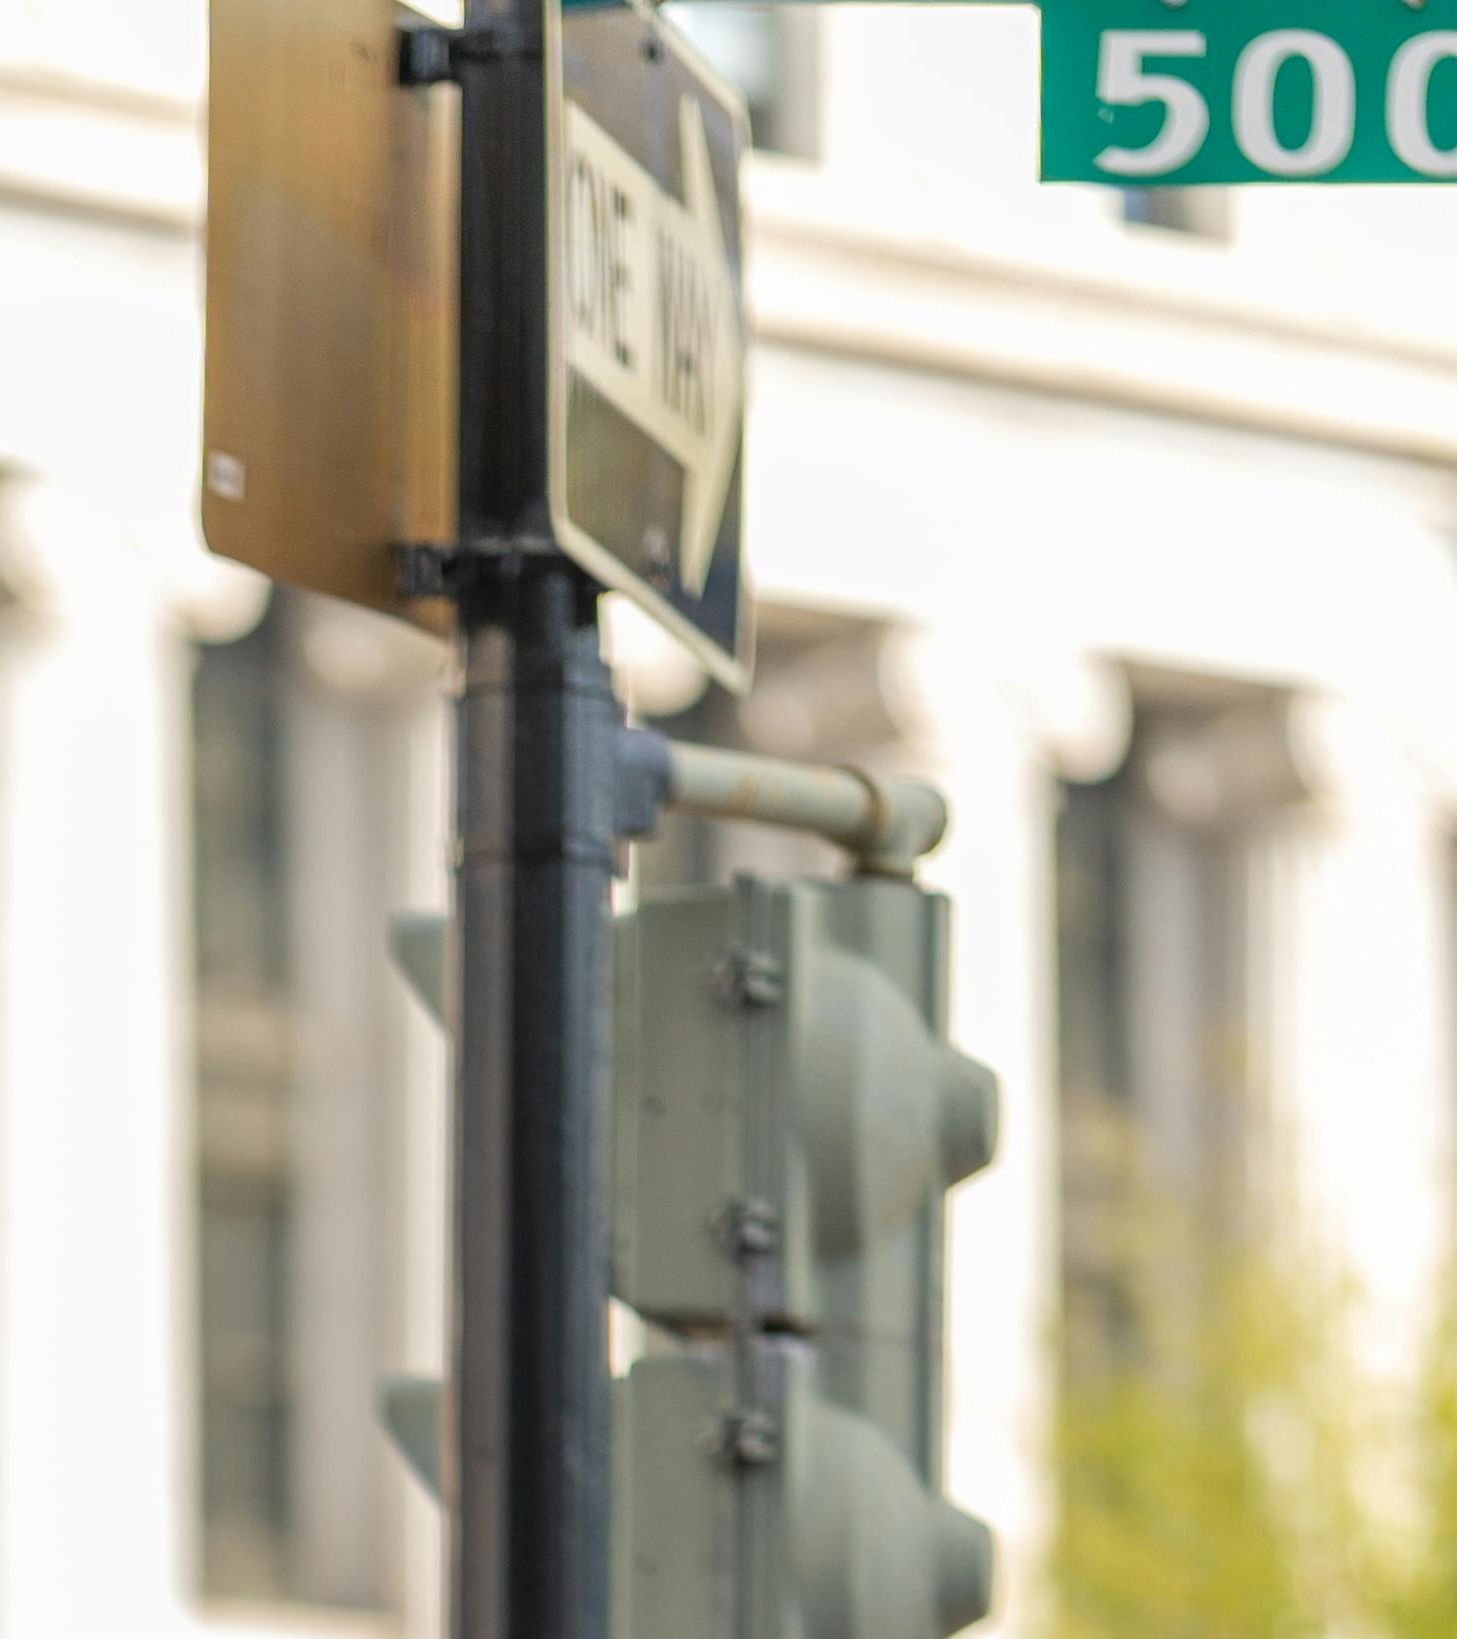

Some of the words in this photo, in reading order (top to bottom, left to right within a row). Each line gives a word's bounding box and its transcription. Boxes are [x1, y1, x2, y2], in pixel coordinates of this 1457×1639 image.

[1091, 27, 1457, 178] 500
[566, 150, 638, 374] ONE
[652, 222, 716, 438] WAY
